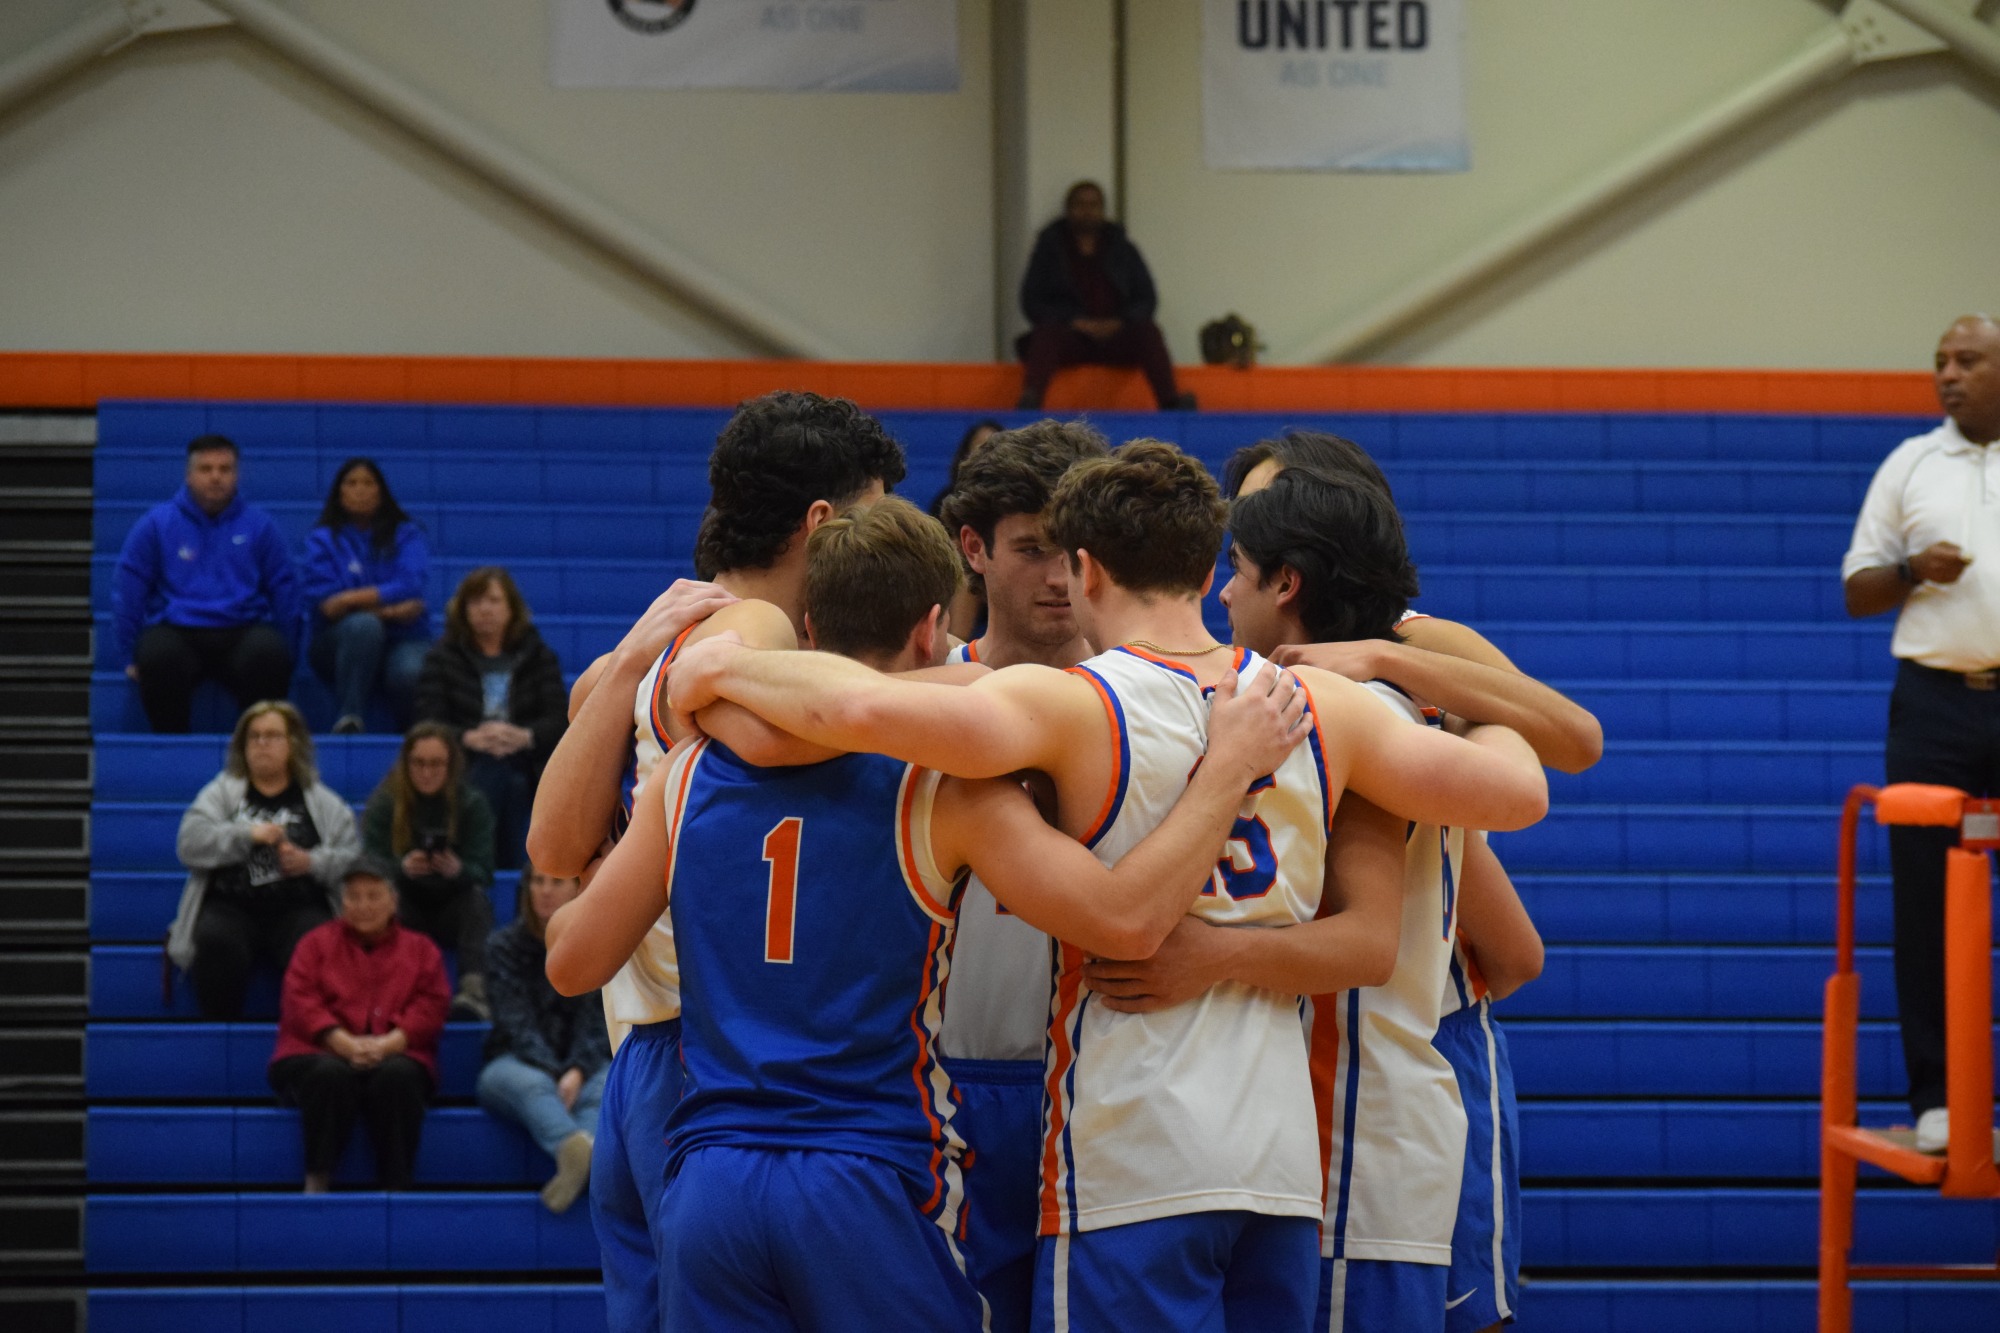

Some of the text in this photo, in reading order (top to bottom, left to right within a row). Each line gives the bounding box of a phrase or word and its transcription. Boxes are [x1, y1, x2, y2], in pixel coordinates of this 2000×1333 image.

[1238, 0, 1427, 50] UNITED
[1328, 59, 1386, 87] ONE
[761, 816, 804, 964] 1
